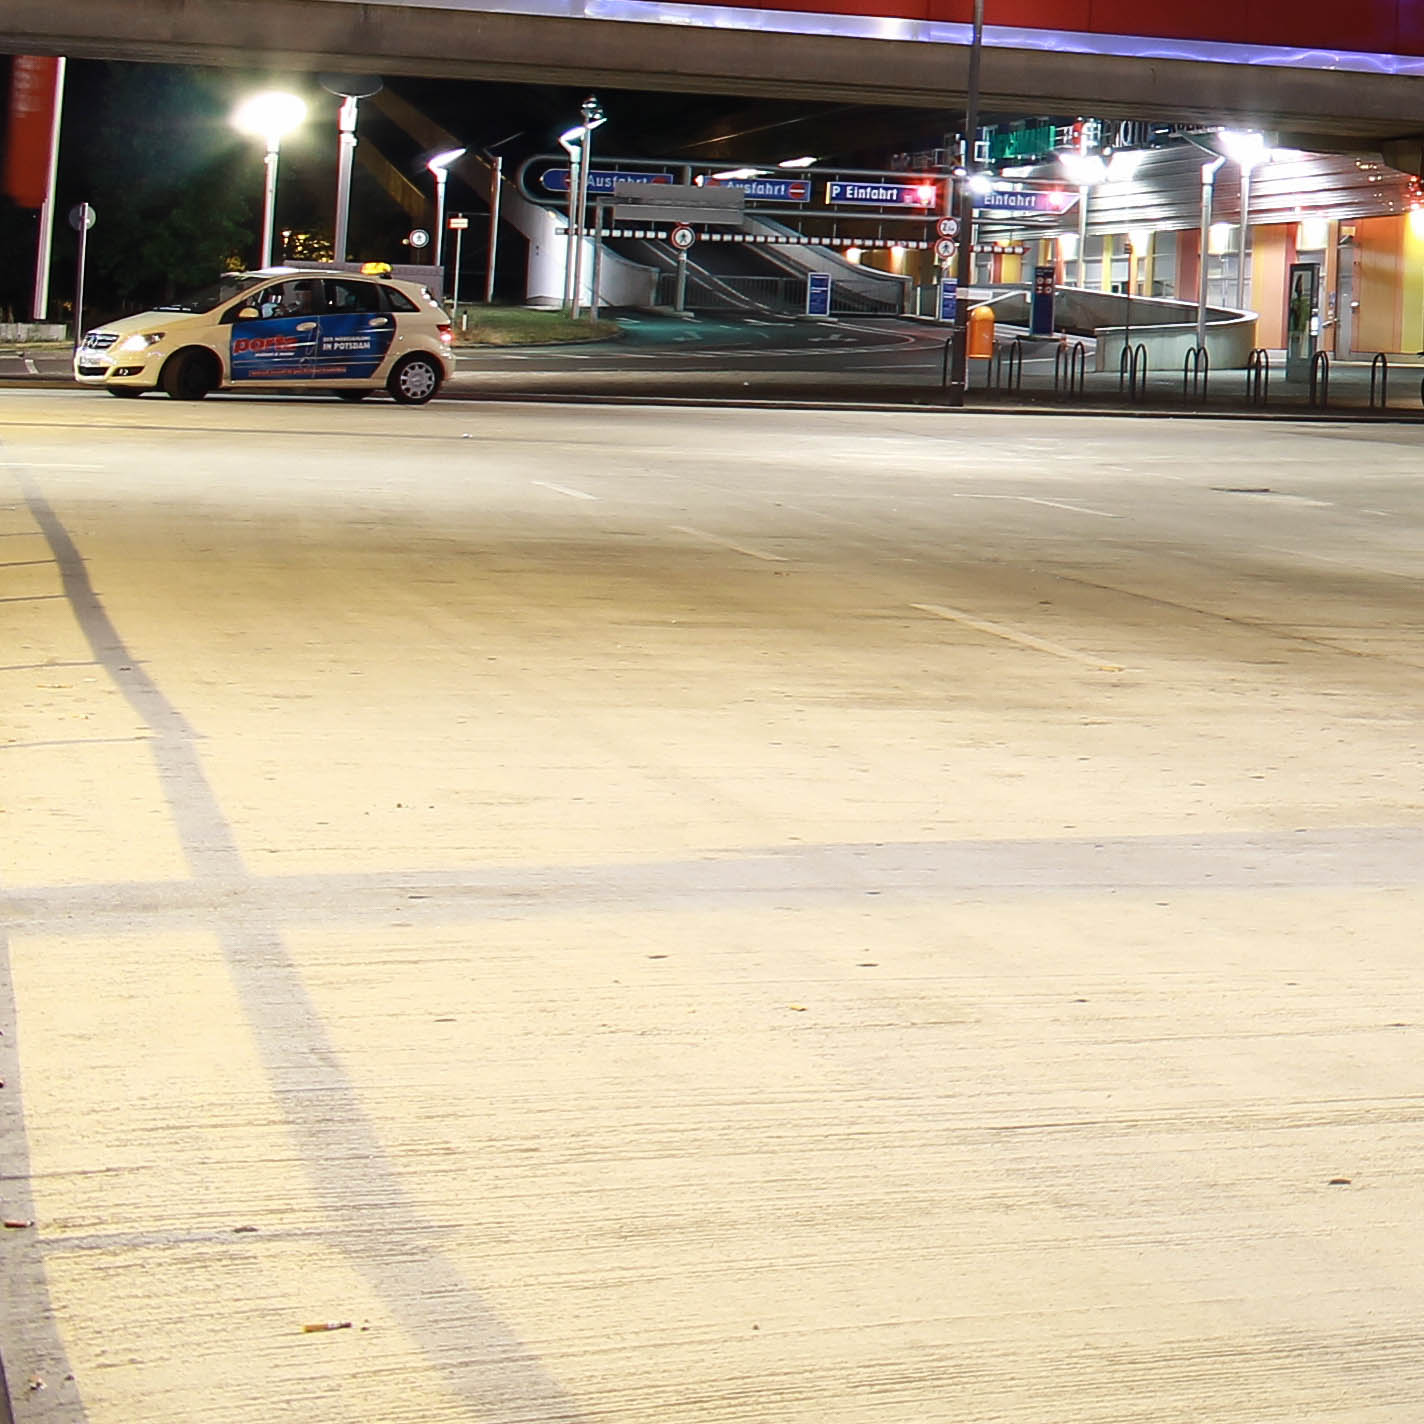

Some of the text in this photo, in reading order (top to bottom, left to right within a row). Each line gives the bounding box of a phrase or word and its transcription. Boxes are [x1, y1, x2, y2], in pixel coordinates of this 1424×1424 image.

[831, 186, 898, 201] P Einfahrt
[984, 193, 1036, 207] Einfahrt
